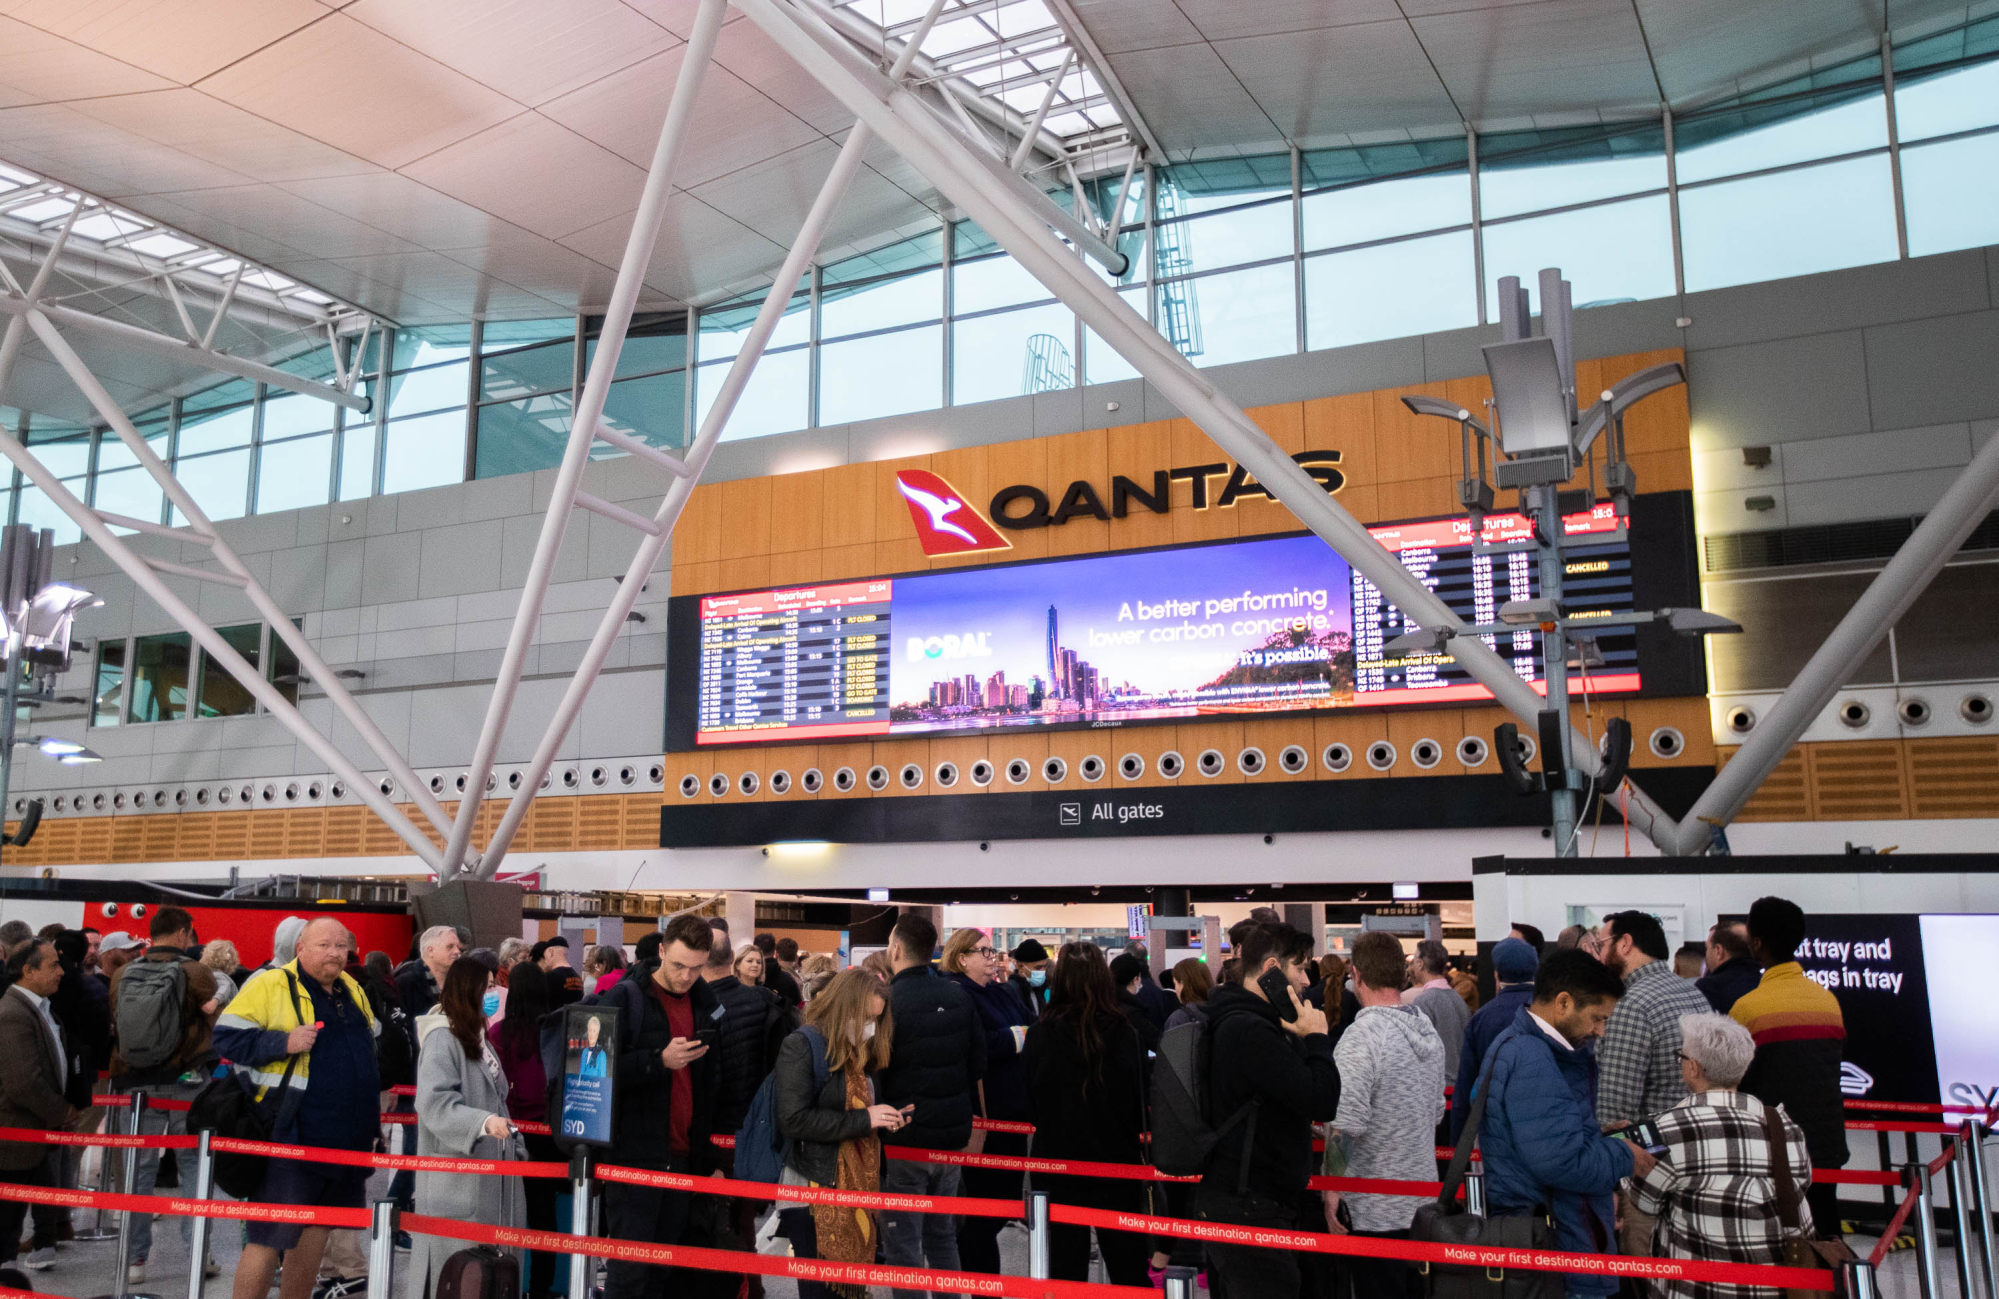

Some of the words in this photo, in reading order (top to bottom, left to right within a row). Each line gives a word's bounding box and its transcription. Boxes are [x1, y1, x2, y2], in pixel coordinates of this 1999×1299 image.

[989, 450, 1346, 530] QANTAS
[1593, 508, 1613, 519] 15:0
[1452, 518, 1514, 533] Detures
[1400, 548, 1431, 556] Canberra
[1401, 555, 1438, 564] Melbourne
[1566, 561, 1609, 573] CANCELLED
[773, 590, 816, 602] Departures
[1118, 602, 1134, 622] A
[1138, 599, 1201, 621] better
[1205, 587, 1328, 618] performing
[856, 615, 877, 623] CLOSED
[1088, 627, 1145, 647] lower
[1151, 620, 1225, 642] carbon
[907, 632, 992, 663] BORAL
[1240, 652, 1263, 666] It's
[1264, 646, 1332, 667] possible.
[1357, 659, 1400, 669] Delayed-Late
[1400, 657, 1422, 666] Arrival
[1423, 656, 1432, 664] Of
[1433, 656, 1455, 664] Opera
[1406, 665, 1437, 673] Canberra
[1406, 673, 1436, 681] Brisbane
[846, 709, 876, 717] CANCELLED
[1092, 802, 1114, 820] All
[1118, 802, 1164, 824] gates
[1813, 938, 1851, 963] tray
[1853, 938, 1891, 960] and
[1802, 967, 1840, 990] ags
[1842, 966, 1861, 987] in
[1863, 967, 1903, 994] tray
[564, 1119, 585, 1135] SYD
[983, 1121, 995, 1129] first
[996, 1122, 1031, 1132] destination
[45, 1133, 60, 1142] Make
[60, 1135, 72, 1143] your
[73, 1134, 83, 1143] first
[84, 1135, 114, 1144] destination
[114, 1137, 145, 1146] qantas.com
[212, 1140, 225, 1149] your
[226, 1141, 238, 1149] first
[238, 1142, 270, 1151] destination
[271, 1146, 305, 1156] qantas.com
[372, 1156, 390, 1165] Make
[390, 1158, 405, 1167] your
[406, 1157, 418, 1166] first
[419, 1158, 455, 1169] destination
[457, 1162, 495, 1171] qantas.com
[928, 1152, 948, 1161] Make
[949, 1155, 965, 1164] your
[966, 1155, 980, 1164] first
[981, 1156, 1022, 1168] destination
[1024, 1161, 1067, 1171] qantas.com
[597, 1167, 610, 1176] first
[611, 1168, 651, 1181] destination
[652, 1176, 693, 1187] qantas.com
[3, 1186, 15, 1196] first
[16, 1187, 54, 1200] destination
[55, 1193, 94, 1204] qantas.com
[777, 1188, 799, 1199] Make
[800, 1190, 818, 1201] your
[819, 1190, 835, 1201] first
[836, 1192, 882, 1205] destination
[884, 1197, 933, 1209] qantas.com
[171, 1201, 191, 1212] Make
[192, 1203, 210, 1214] your
[210, 1203, 225, 1214] first
[226, 1205, 269, 1217] destination
[270, 1208, 315, 1220] qantas.com
[1118, 1216, 1146, 1228] Make
[1147, 1221, 1170, 1232] your
[1172, 1222, 1191, 1233] first
[1193, 1224, 1251, 1240] destination
[1255, 1233, 1317, 1247] qantas.com
[495, 1229, 519, 1242] Make
[521, 1234, 542, 1246] your
[543, 1235, 561, 1247] first
[562, 1238, 614, 1254] destination
[617, 1245, 673, 1260] qantas.com
[1445, 1248, 1476, 1260] Make
[1479, 1252, 1506, 1264] your
[1508, 1252, 1532, 1265] first
[1534, 1254, 1605, 1270] destination
[1608, 1259, 1683, 1275] qantas.com
[788, 1261, 817, 1275] Make
[819, 1267, 843, 1279] your
[846, 1266, 867, 1280] first
[869, 1268, 933, 1286] destination
[936, 1276, 1003, 1292] qantas.com
